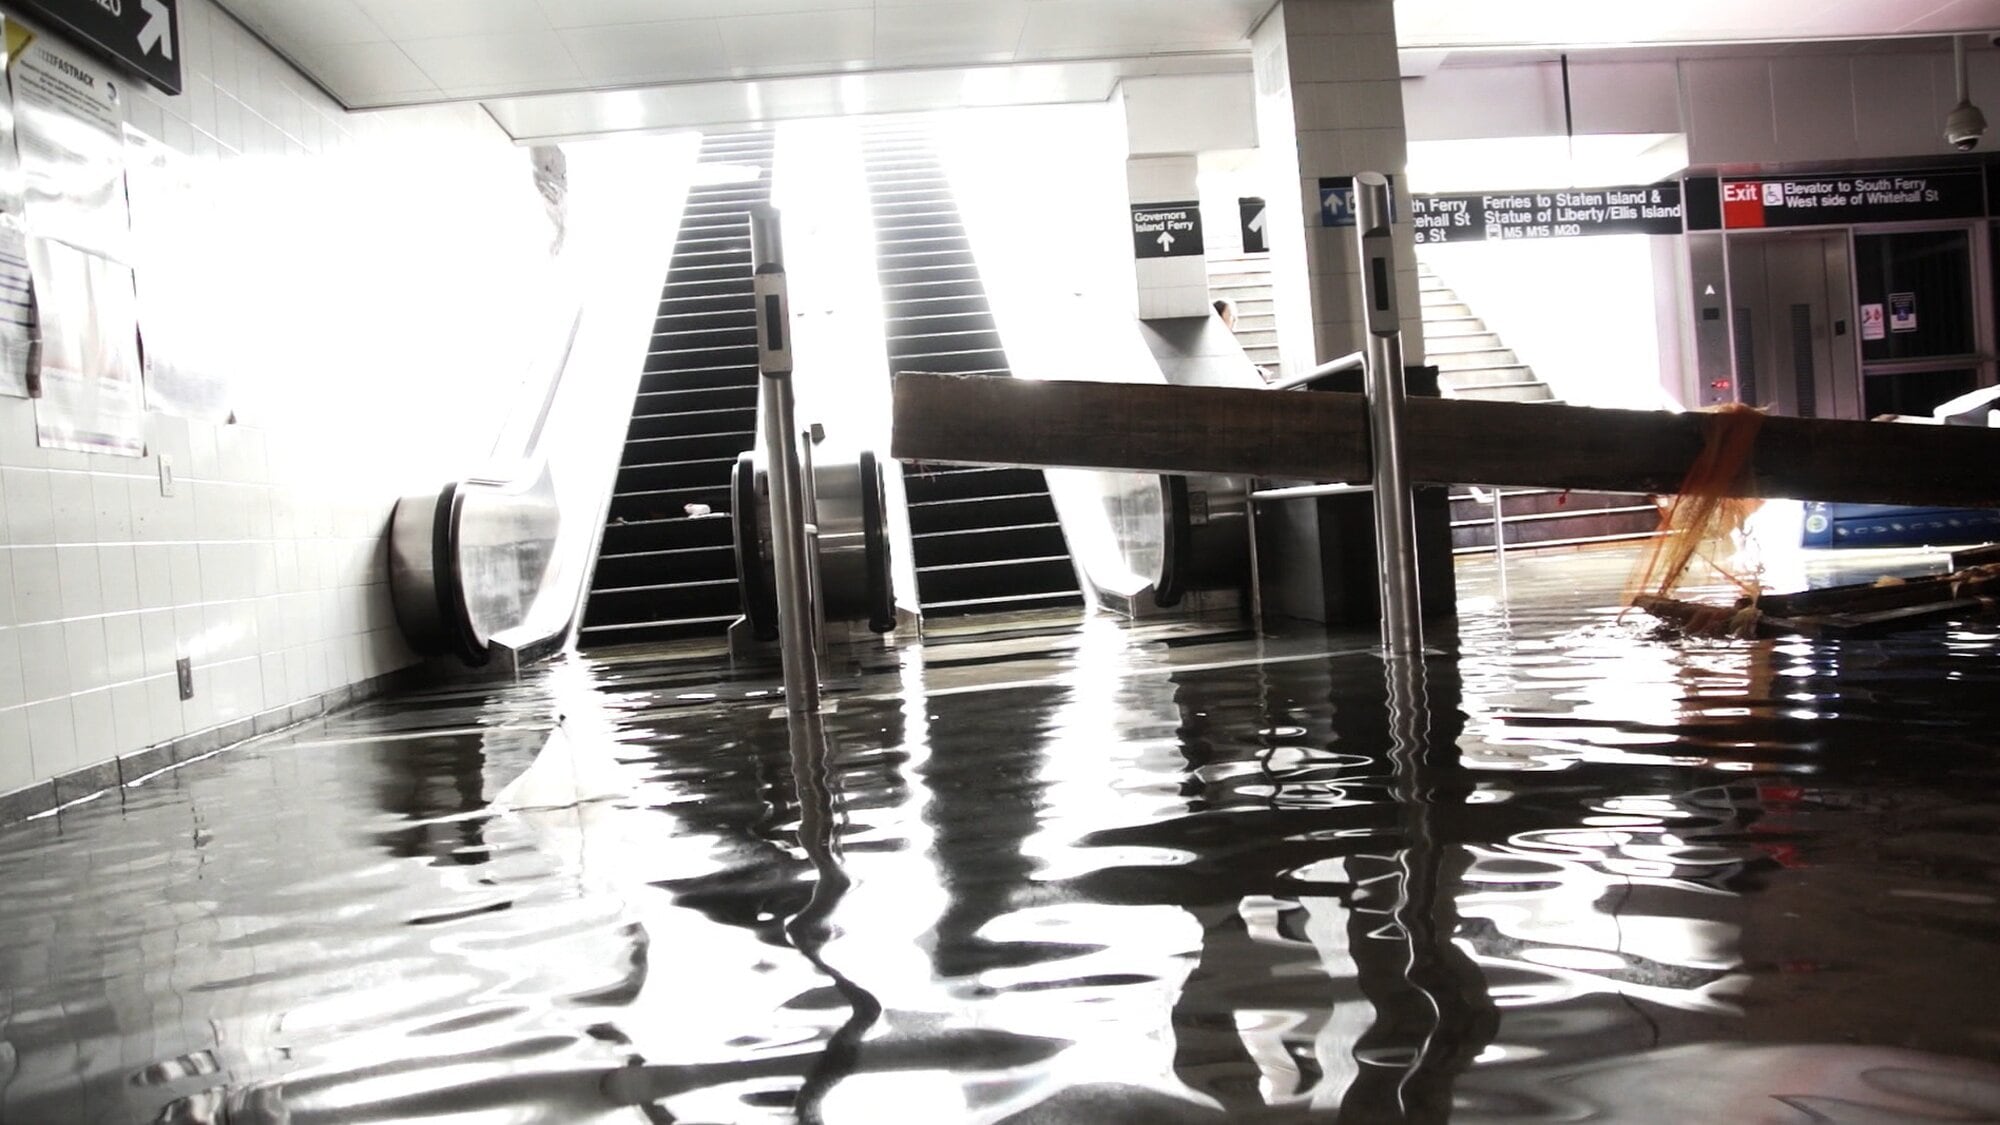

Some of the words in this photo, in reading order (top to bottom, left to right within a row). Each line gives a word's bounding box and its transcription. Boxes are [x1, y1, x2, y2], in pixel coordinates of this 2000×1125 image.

[1723, 183, 1758, 202] Exit
[1784, 181, 1833, 195] Elevator
[1838, 181, 1851, 193] to
[1855, 179, 1892, 192] South
[1895, 177, 1927, 192] Ferry
[1411, 198, 1426, 213] th
[1429, 198, 1468, 214] Ferry
[1482, 195, 1532, 210] Ferries
[1536, 194, 1552, 208] to
[1556, 192, 1602, 207] Staten
[1606, 190, 1647, 205] Island
[1651, 189, 1662, 204] &
[1785, 195, 1818, 208] West
[1821, 193, 1847, 207] side
[1850, 192, 1863, 206] of
[1866, 190, 1921, 204] Whitehall
[1925, 189, 1940, 202] St
[1134, 212, 1187, 222] Governors
[1413, 213, 1450, 228] ehall
[1454, 211, 1471, 227] St
[1484, 209, 1533, 224] Statue
[1537, 208, 1553, 223] of
[1641, 203, 1681, 219] Island
[1135, 222, 1165, 232] Island
[1167, 220, 1194, 231] Ferry
[1429, 227, 1447, 242] St
[1503, 226, 1523, 239] M5
[1526, 225, 1550, 237] M15
[1554, 223, 1581, 237] M20
